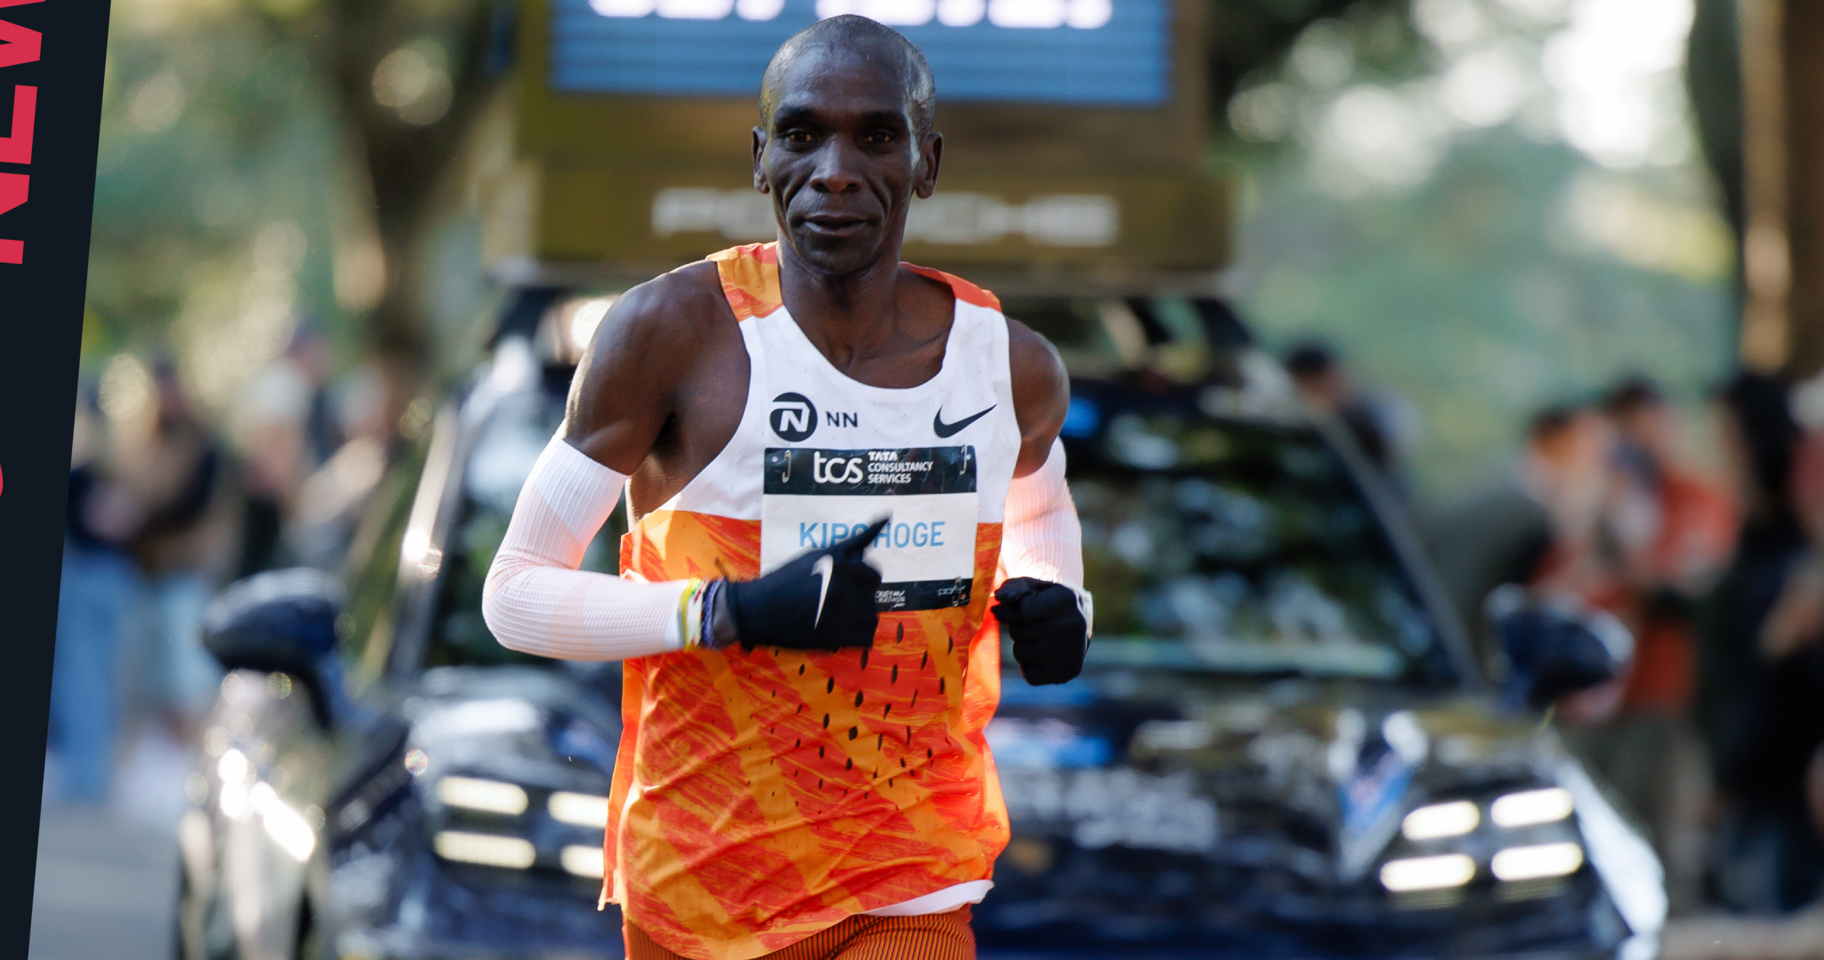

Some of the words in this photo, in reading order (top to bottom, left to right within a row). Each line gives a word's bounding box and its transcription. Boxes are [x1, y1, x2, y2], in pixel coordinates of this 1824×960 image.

[825, 411, 858, 428] NN
[868, 451, 898, 461] TATA
[813, 451, 864, 484] tcs
[867, 461, 934, 473] CONSULTANCY
[867, 473, 912, 484] SERVICES
